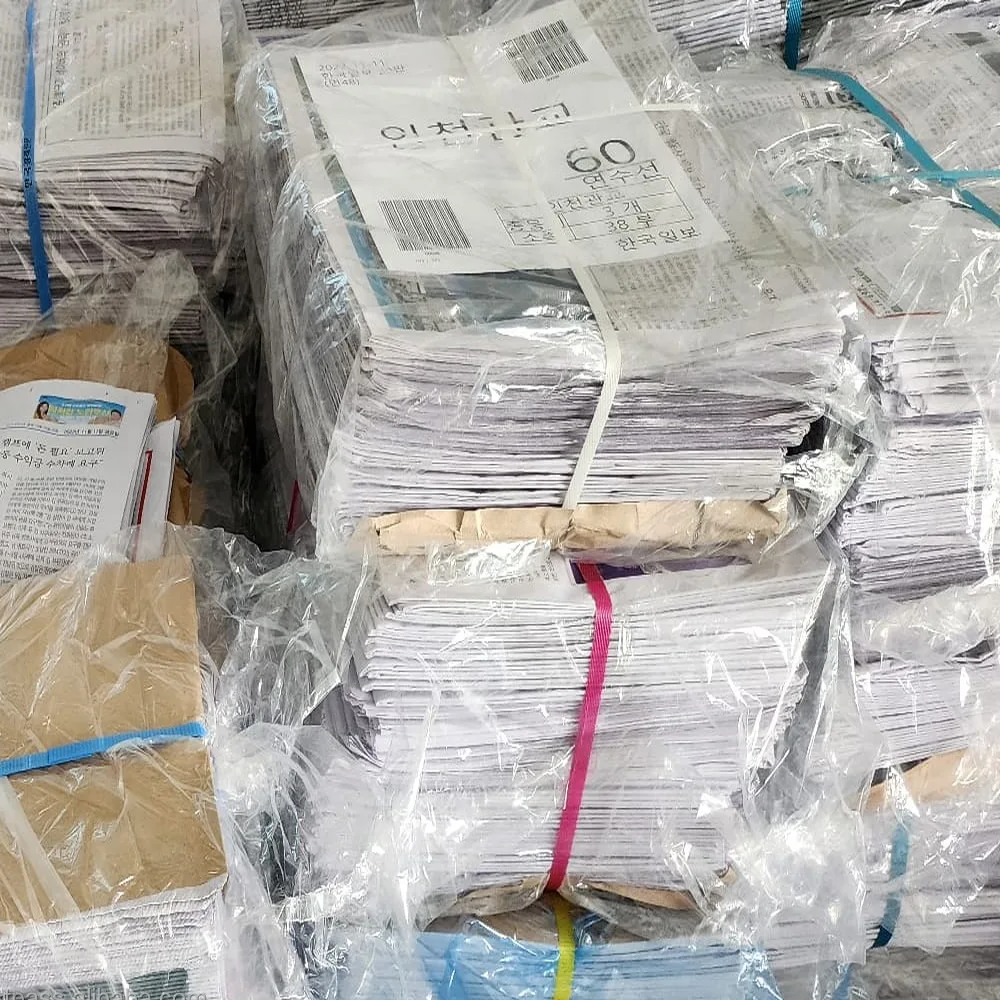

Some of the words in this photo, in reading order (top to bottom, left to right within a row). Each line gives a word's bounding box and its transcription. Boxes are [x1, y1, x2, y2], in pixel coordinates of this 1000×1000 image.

[566, 139, 636, 173] 60
[624, 200, 643, 213] 개
[616, 226, 701, 251] 한국일보
